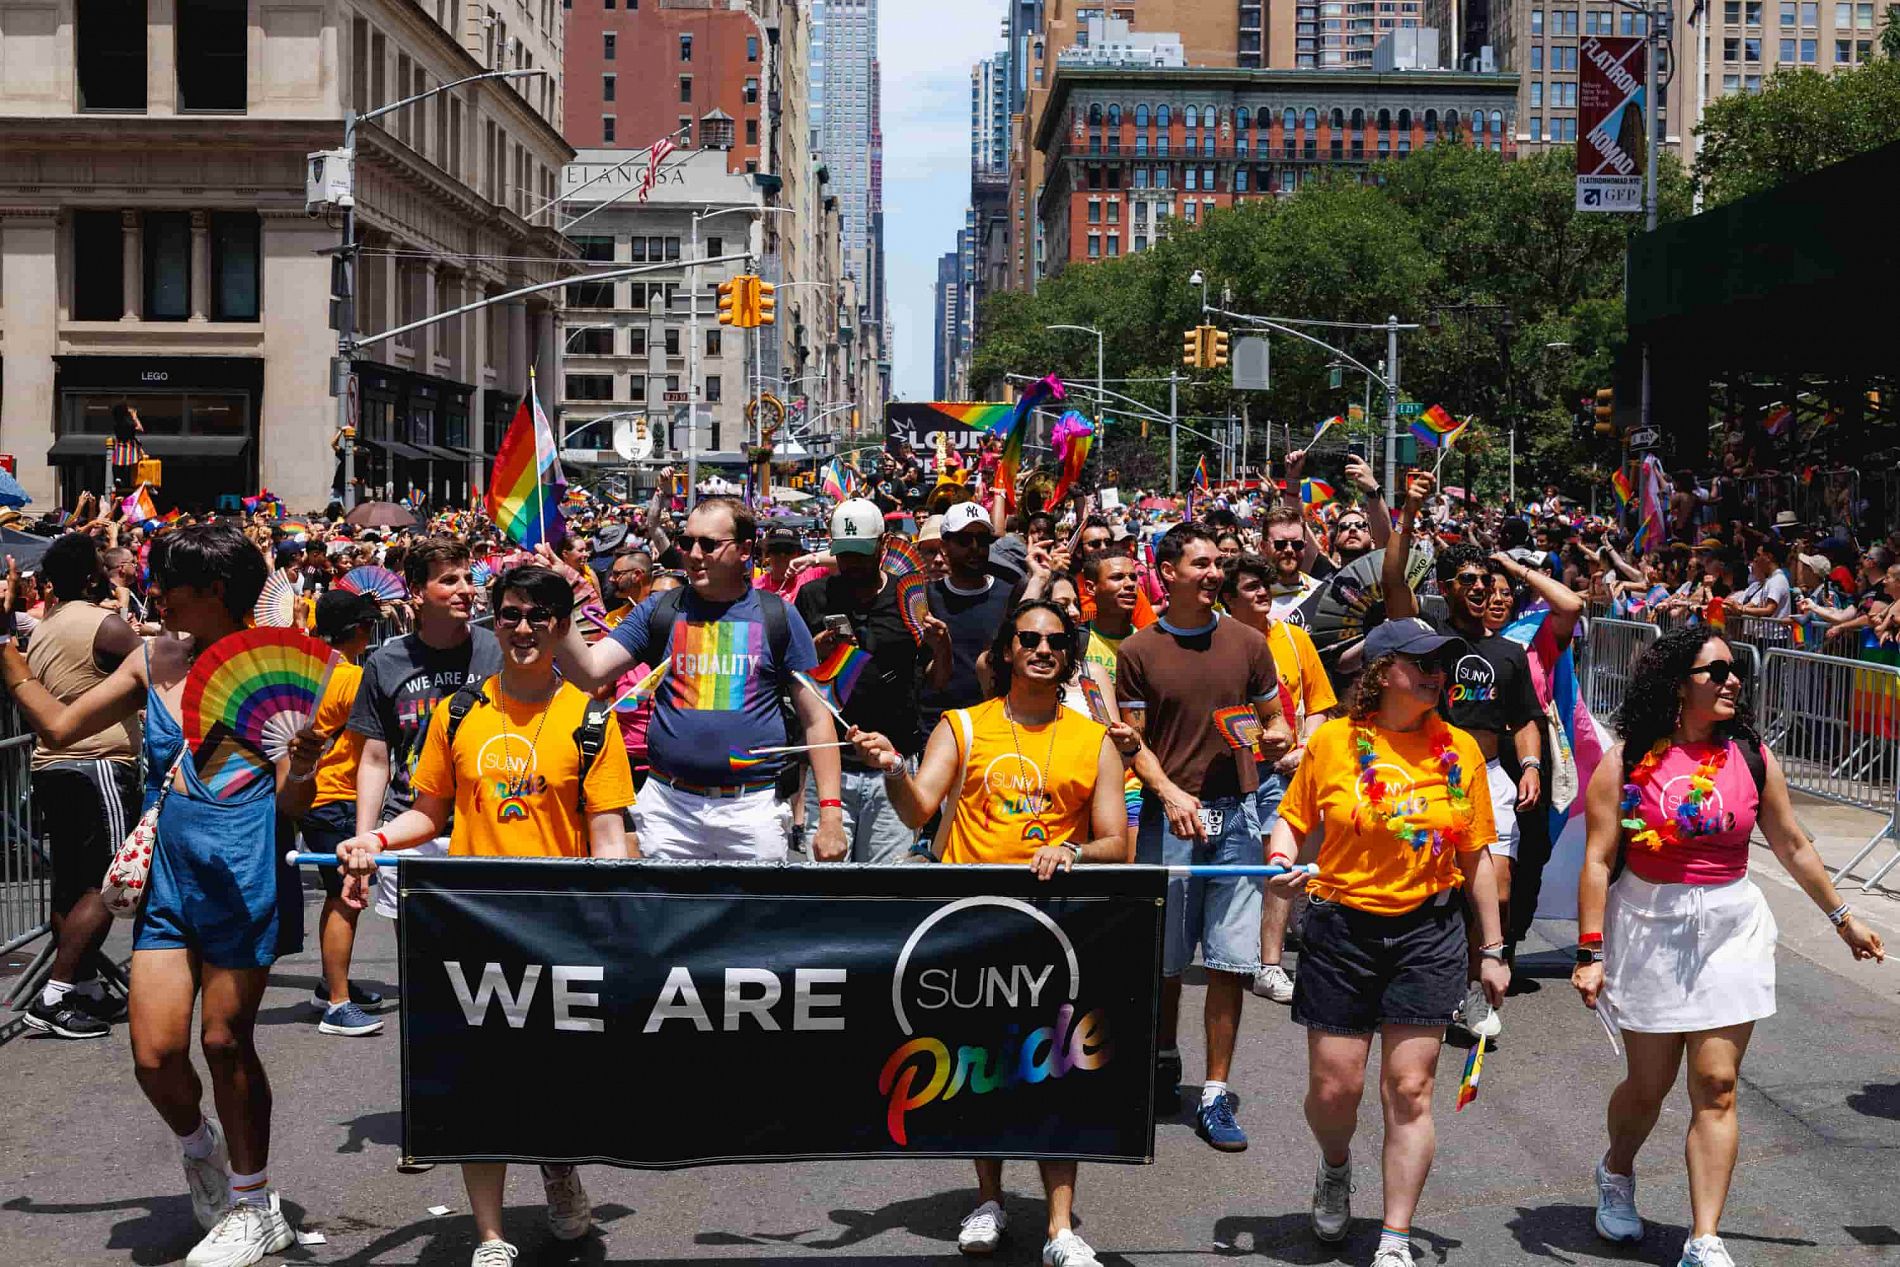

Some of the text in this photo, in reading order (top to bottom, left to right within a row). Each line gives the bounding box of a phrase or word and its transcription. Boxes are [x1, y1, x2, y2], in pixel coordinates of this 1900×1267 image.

[1581, 36, 1641, 96] FLATIRON
[1585, 126, 1635, 175] NOMAD
[1605, 189, 1636, 200] GFP
[141, 371, 169, 380] LEGO
[844, 517, 857, 535] LA
[676, 653, 761, 677] EQUALITY
[1460, 667, 1490, 683] SUNY
[406, 676, 431, 693] WE
[434, 671, 462, 686] ARE
[1448, 683, 1497, 708] Pride
[484, 753, 528, 771] SUNY
[992, 772, 1034, 791] SUNY
[443, 960, 847, 1034] WE ARE
[916, 964, 1055, 1010] SUNY
[878, 1003, 1111, 1147] Pride
